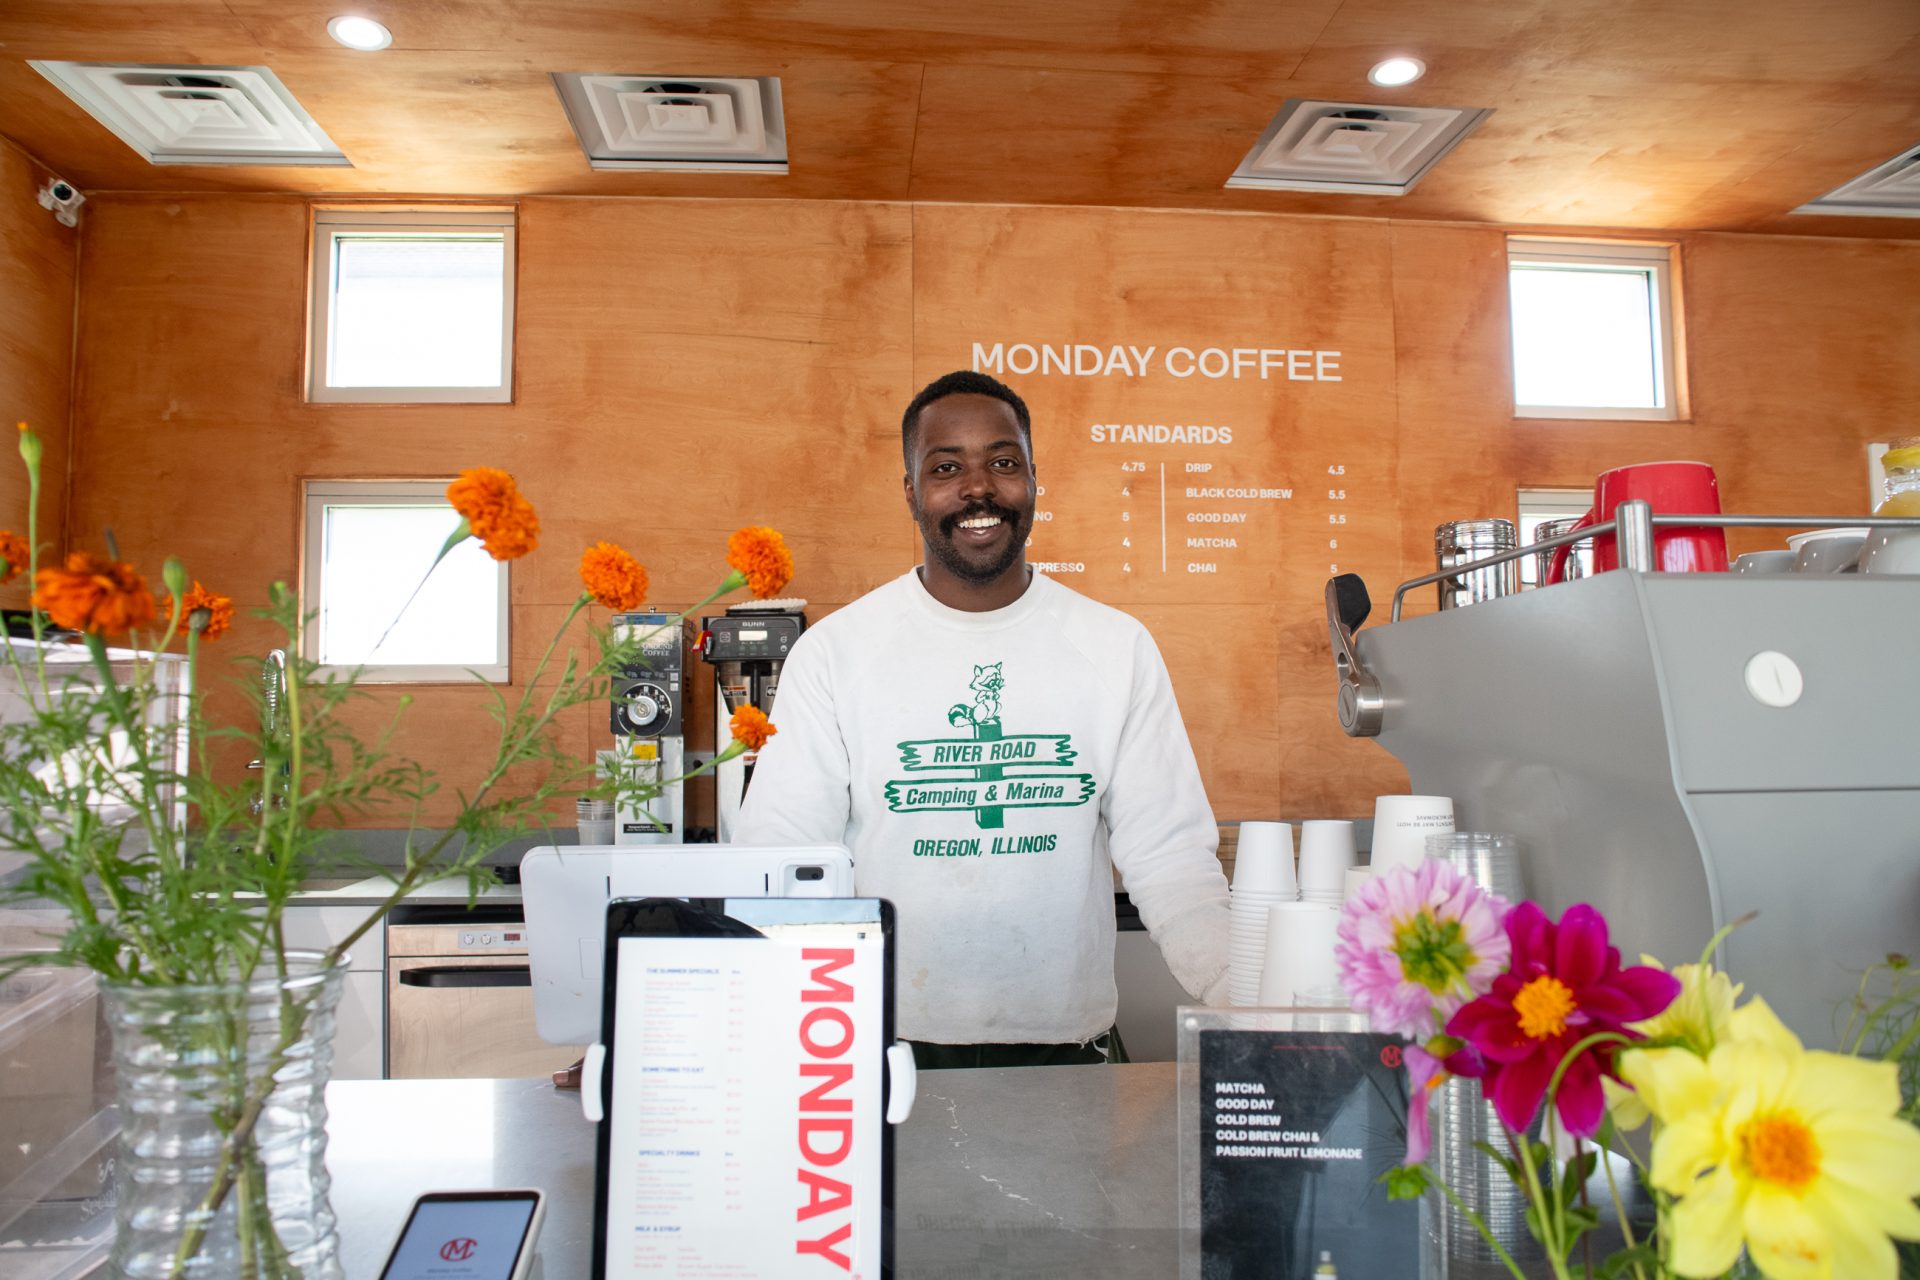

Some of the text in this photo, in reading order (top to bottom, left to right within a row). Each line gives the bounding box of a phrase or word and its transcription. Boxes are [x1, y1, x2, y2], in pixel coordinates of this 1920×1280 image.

[972, 342, 1343, 382] MONDAY COFFEE
[1090, 424, 1233, 445] STANDARDS
[1121, 461, 1146, 472] 4.75
[1186, 462, 1345, 475] DRIP 4.5
[1122, 487, 1130, 497] 4
[1186, 487, 1346, 500] BLACK COLD BREW 5.5
[1122, 511, 1130, 522] 5
[1187, 512, 1346, 524] GOOD DAY 5.5
[1122, 537, 1131, 548] 4
[1187, 538, 1337, 549] MATCHA 6
[1122, 562, 1131, 573] 4
[1187, 562, 1338, 573] CHAI 5
[933, 741, 1036, 763] RIVER ROAD
[906, 782, 1064, 806] Camping & Marina
[913, 834, 1057, 858] OREGON, ILLINOIS
[1215, 1082, 1265, 1094] MATCHA
[796, 947, 855, 1272] MONDAY
[1215, 1098, 1274, 1110] GOOD DAY
[1215, 1114, 1281, 1126] COLD BREW
[1215, 1130, 1320, 1142] COLD BREW CHAI &
[1215, 1146, 1362, 1159] PASSION FRUIT LEMONADE
